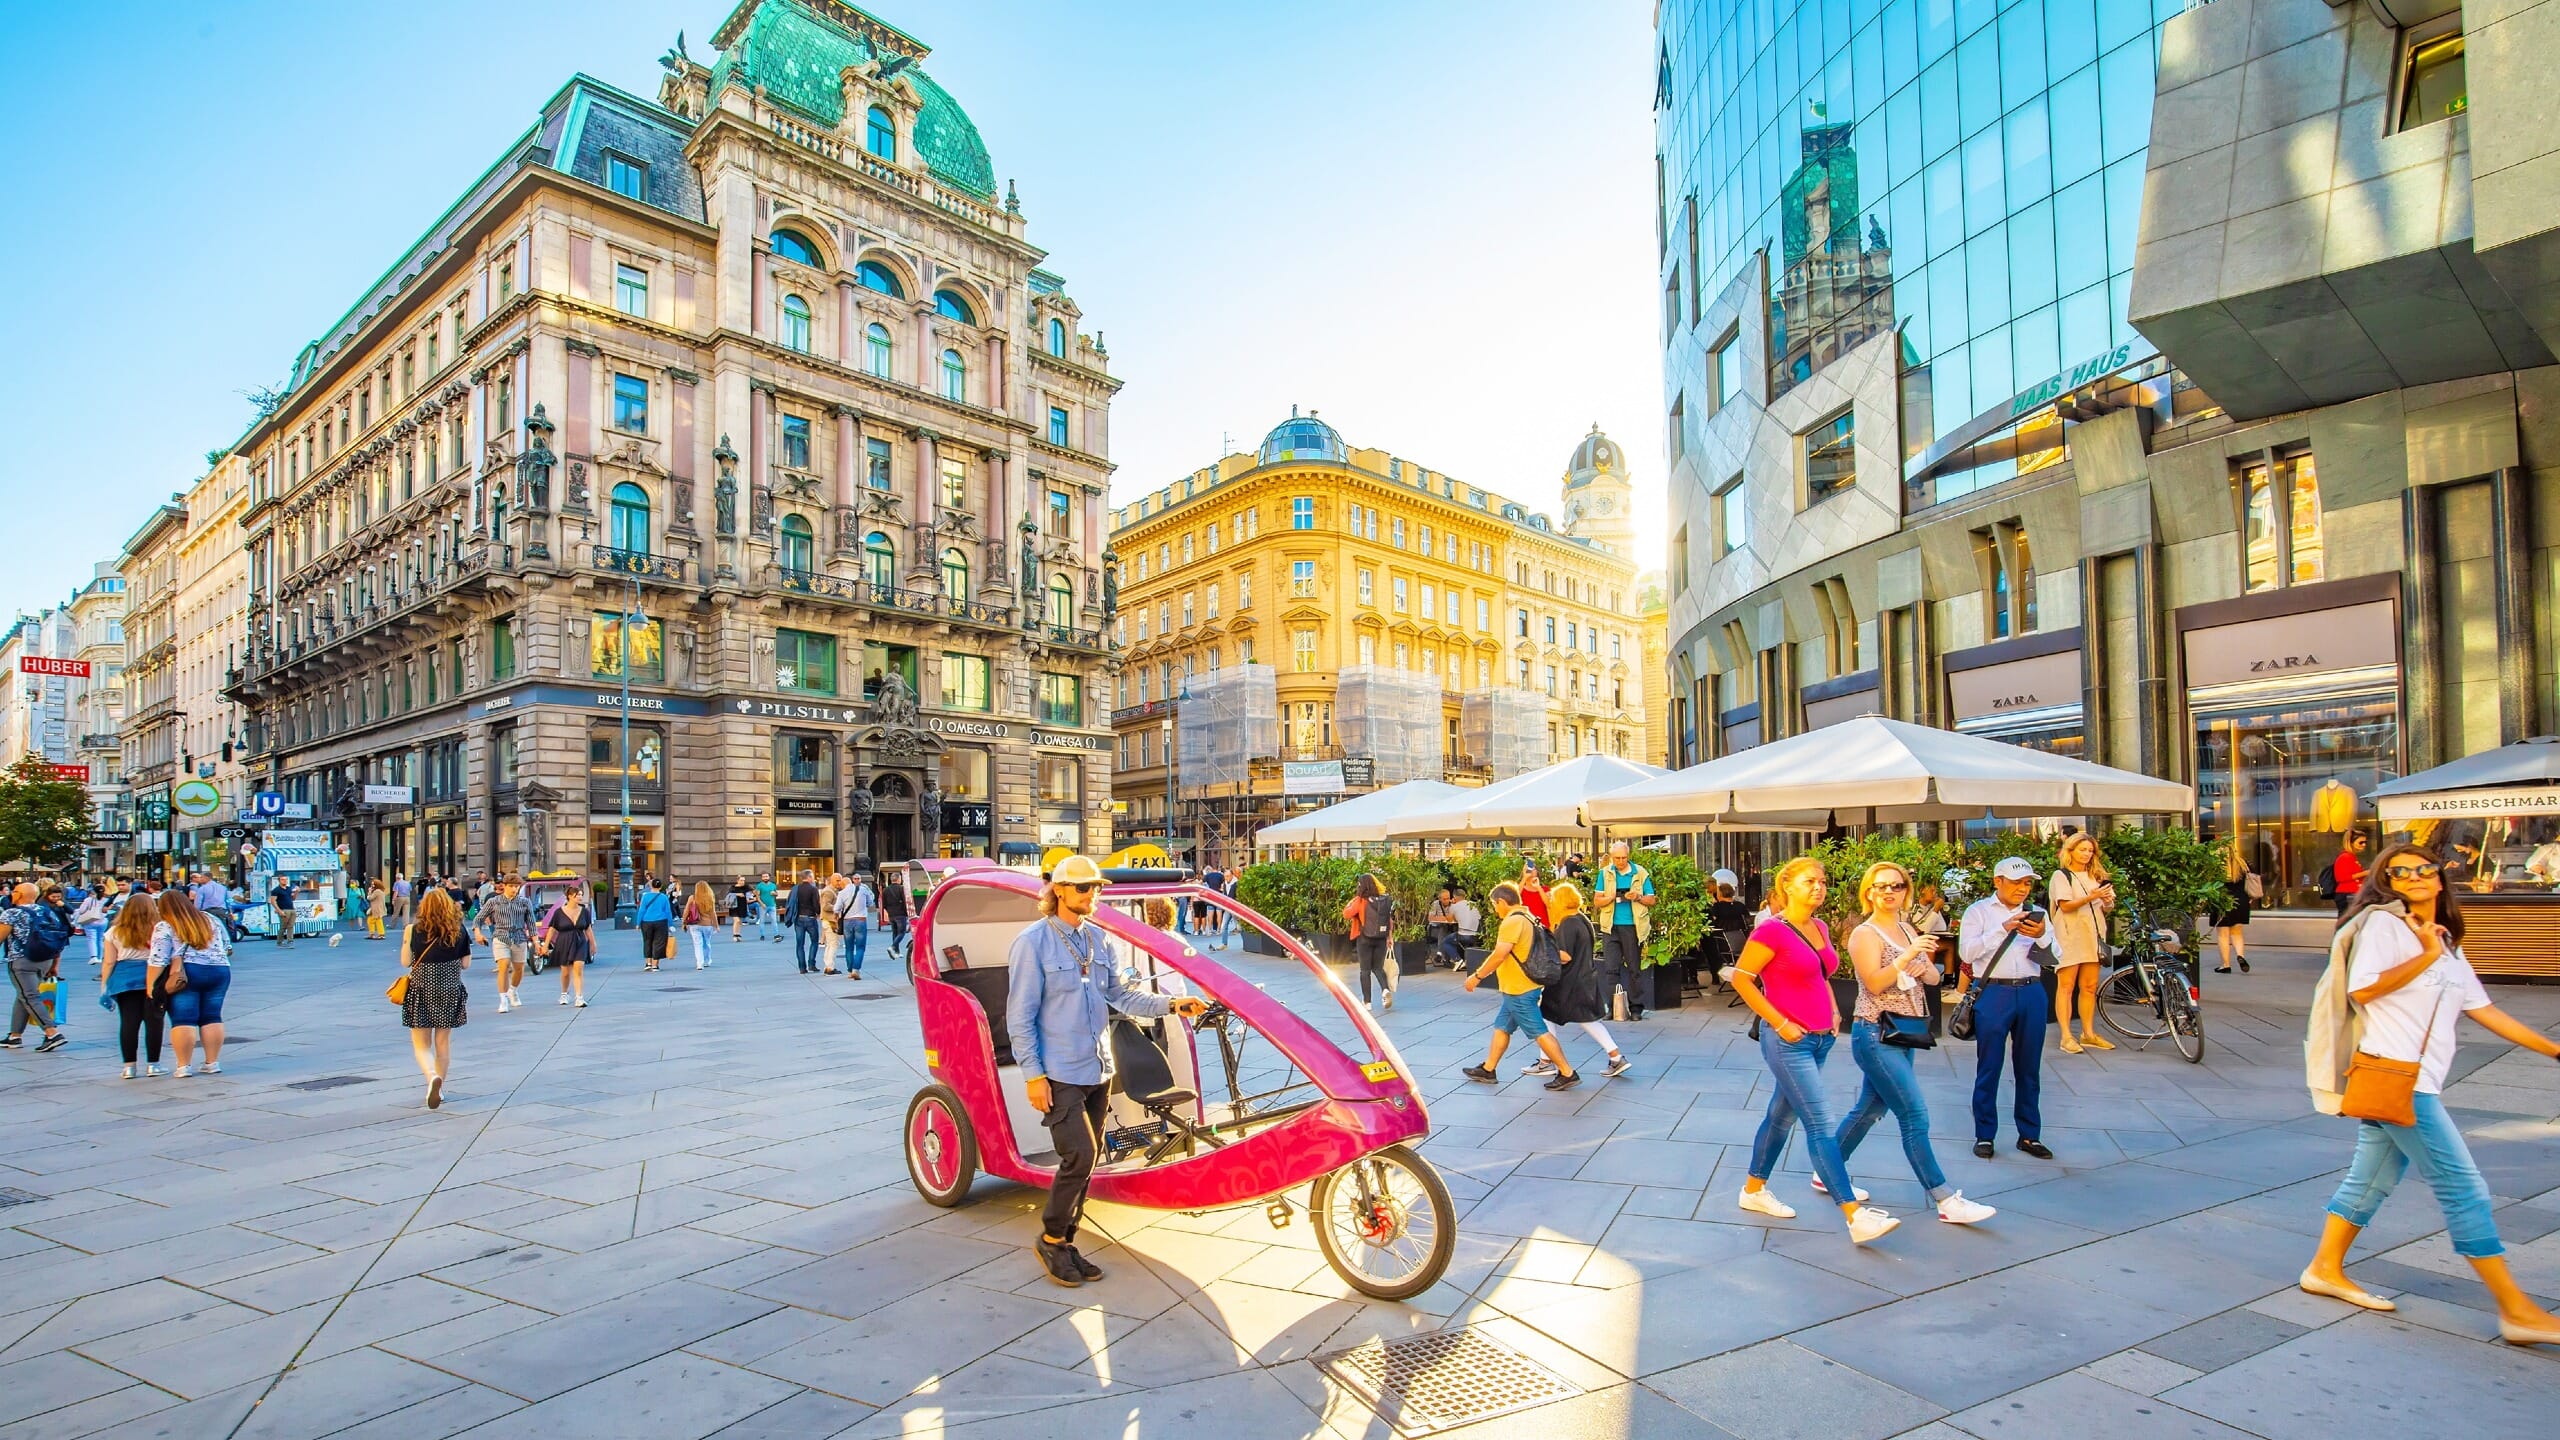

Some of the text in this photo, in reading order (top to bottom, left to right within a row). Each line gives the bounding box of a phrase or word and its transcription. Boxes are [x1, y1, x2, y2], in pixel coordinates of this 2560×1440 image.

[2011, 345, 2130, 416] HAAS HAUS
[24, 658, 84, 675] HUBER
[2250, 654, 2320, 672] ZARA
[1992, 694, 2039, 708] ZARA
[760, 702, 835, 720] PILSTL
[946, 721, 992, 736] OMEGA
[1044, 735, 1084, 748] OMEGA
[370, 789, 407, 797] BUCHERER
[262, 797, 281, 812] U
[608, 798, 649, 806] BUCERER
[2420, 796, 2560, 811] KAISERSCHMAR
[1131, 857, 1166, 868] FAXI
